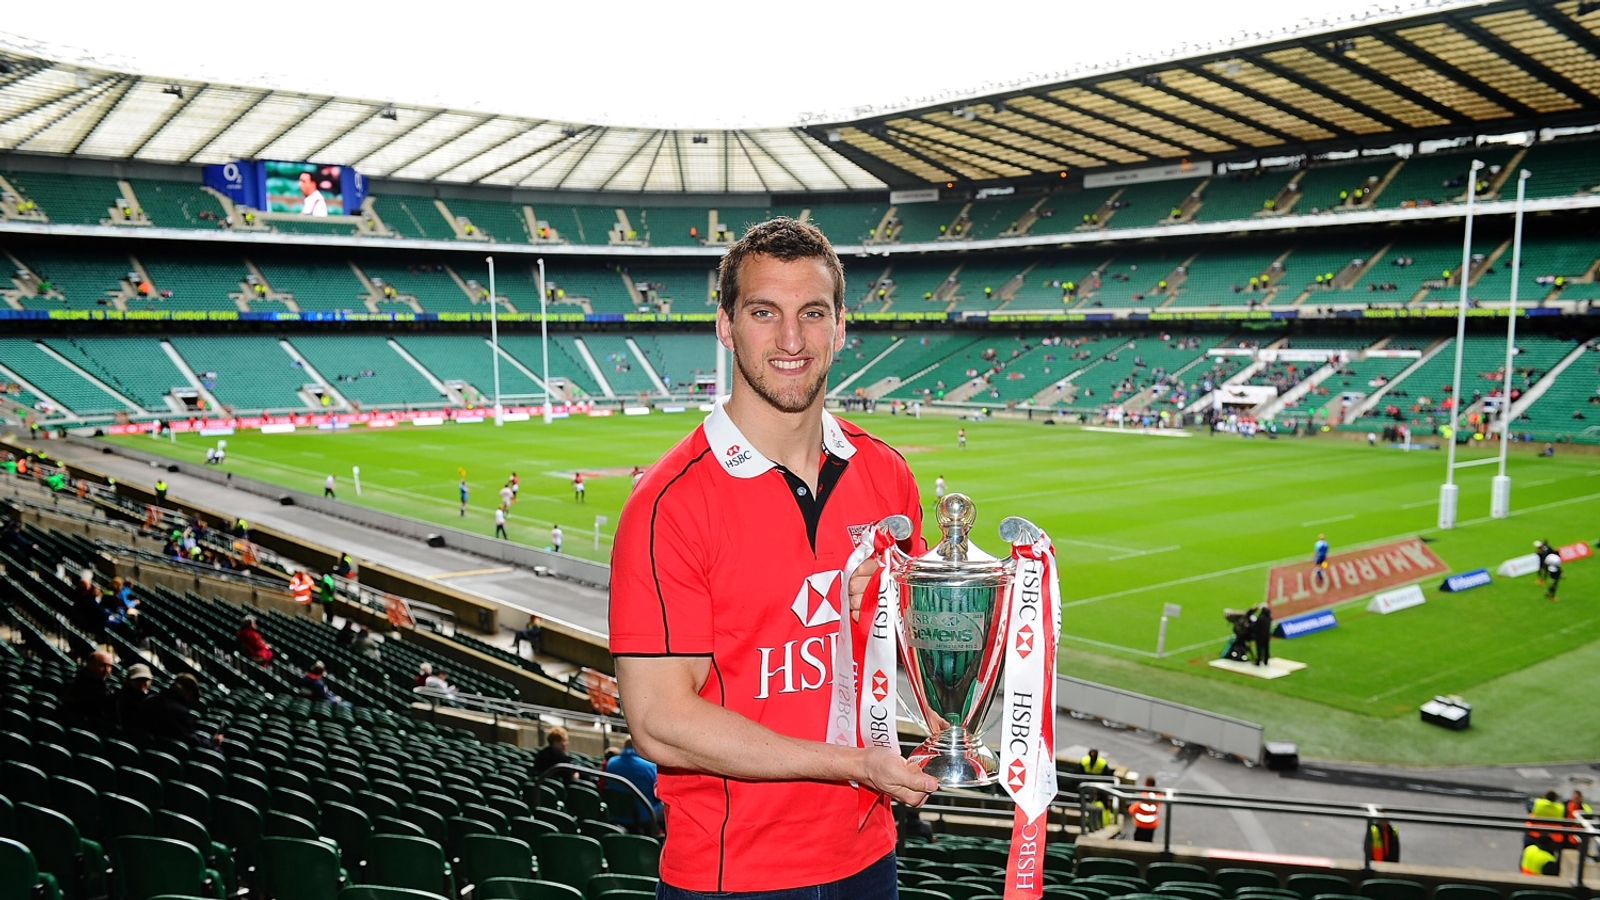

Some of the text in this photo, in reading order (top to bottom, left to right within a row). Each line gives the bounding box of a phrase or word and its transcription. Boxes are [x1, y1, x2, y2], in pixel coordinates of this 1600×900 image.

[725, 450, 753, 469] HSBC
[1018, 559, 1040, 622] HSBC
[1270, 549, 1412, 607] MARRIOTT
[753, 632, 840, 700] HS
[869, 705, 892, 750] HSBC
[1009, 691, 1033, 757] HSBC
[1016, 822, 1039, 890] HSBC
